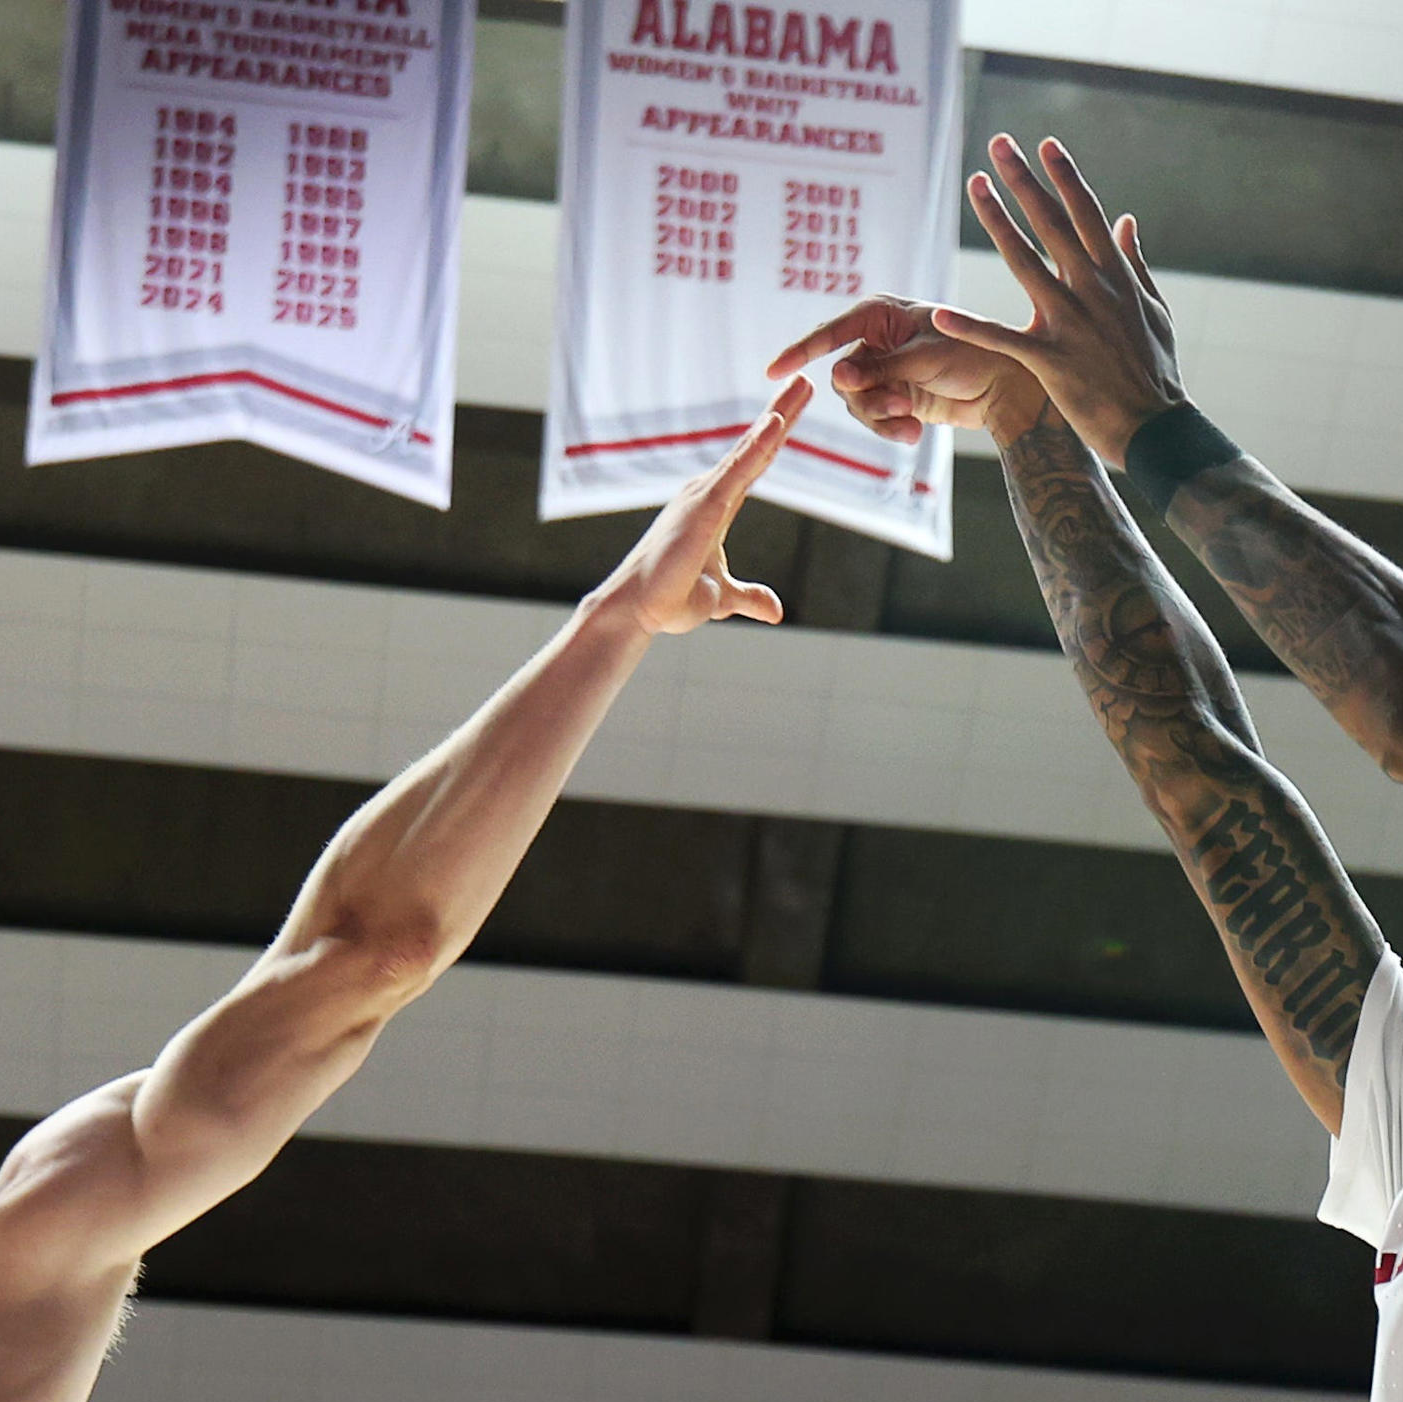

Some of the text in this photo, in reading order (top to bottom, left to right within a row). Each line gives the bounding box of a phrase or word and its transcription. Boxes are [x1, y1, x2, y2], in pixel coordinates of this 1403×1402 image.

[251, 9, 432, 49] BASKETBALL
[630, 0, 899, 75] ALABAMA
[213, 29, 411, 72] TOURNAMENT
[141, 49, 391, 99] APPEARANCES
[607, 51, 921, 107] WOMEN'S BASKETBALL
[641, 104, 885, 155] APPEARANCES
[786, 210, 858, 237] 2011
[784, 238, 862, 266] 2017
[141, 283, 224, 314] 2024
[782, 266, 862, 296] 2022
